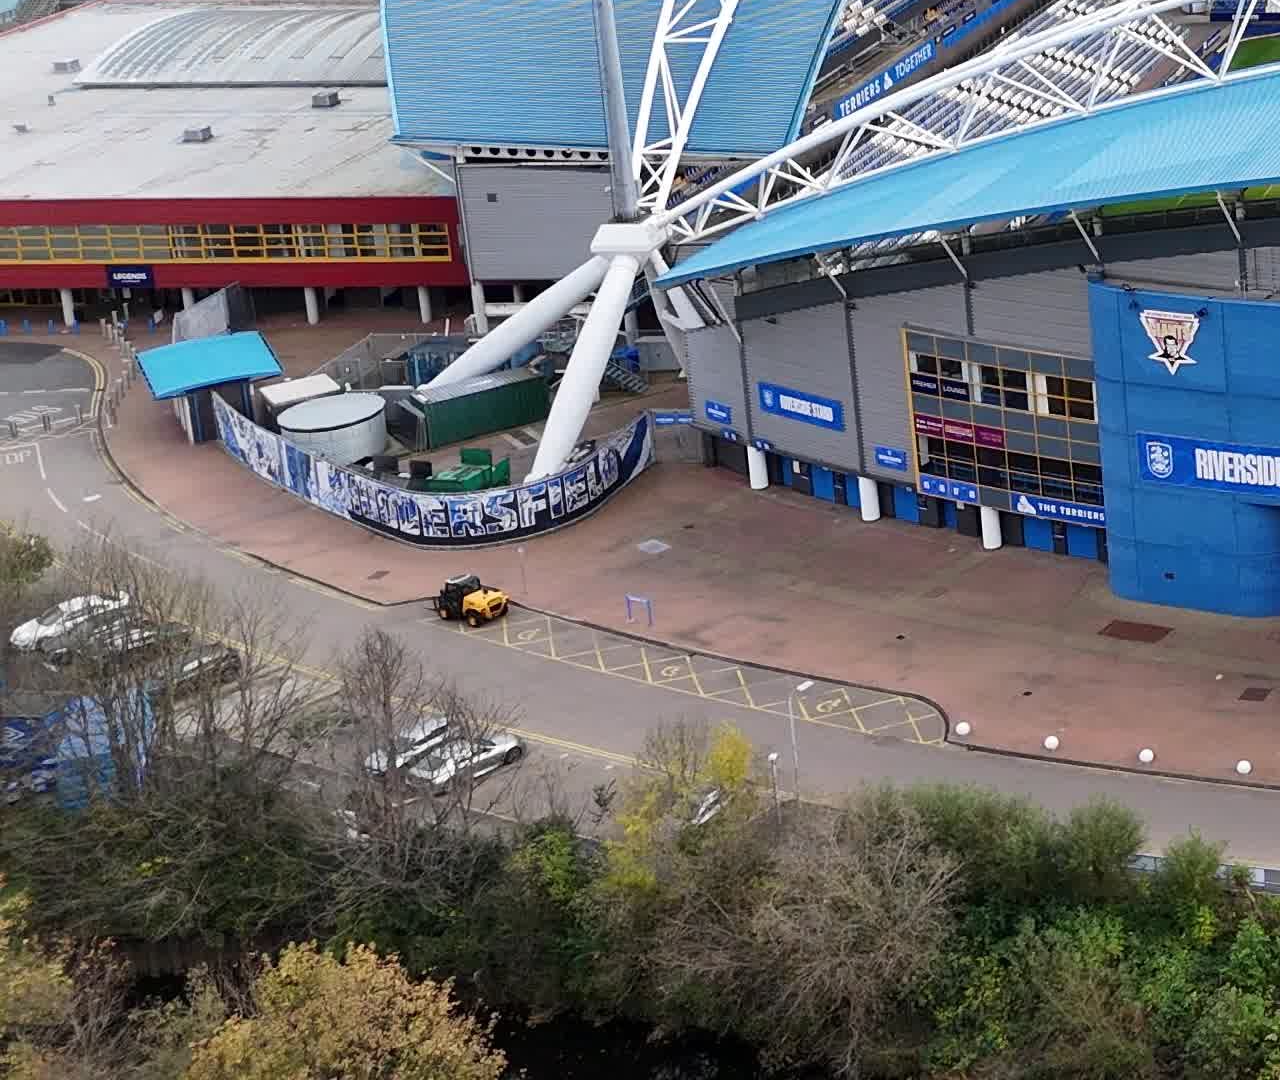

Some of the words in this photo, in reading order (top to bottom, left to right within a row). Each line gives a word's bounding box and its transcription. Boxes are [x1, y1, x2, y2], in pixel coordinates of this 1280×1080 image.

[839, 79, 882, 117] TERRIERS
[894, 43, 933, 79] TOGETHER
[1038, 502, 1057, 513] THE
[1060, 505, 1105, 521] TERRIERS
